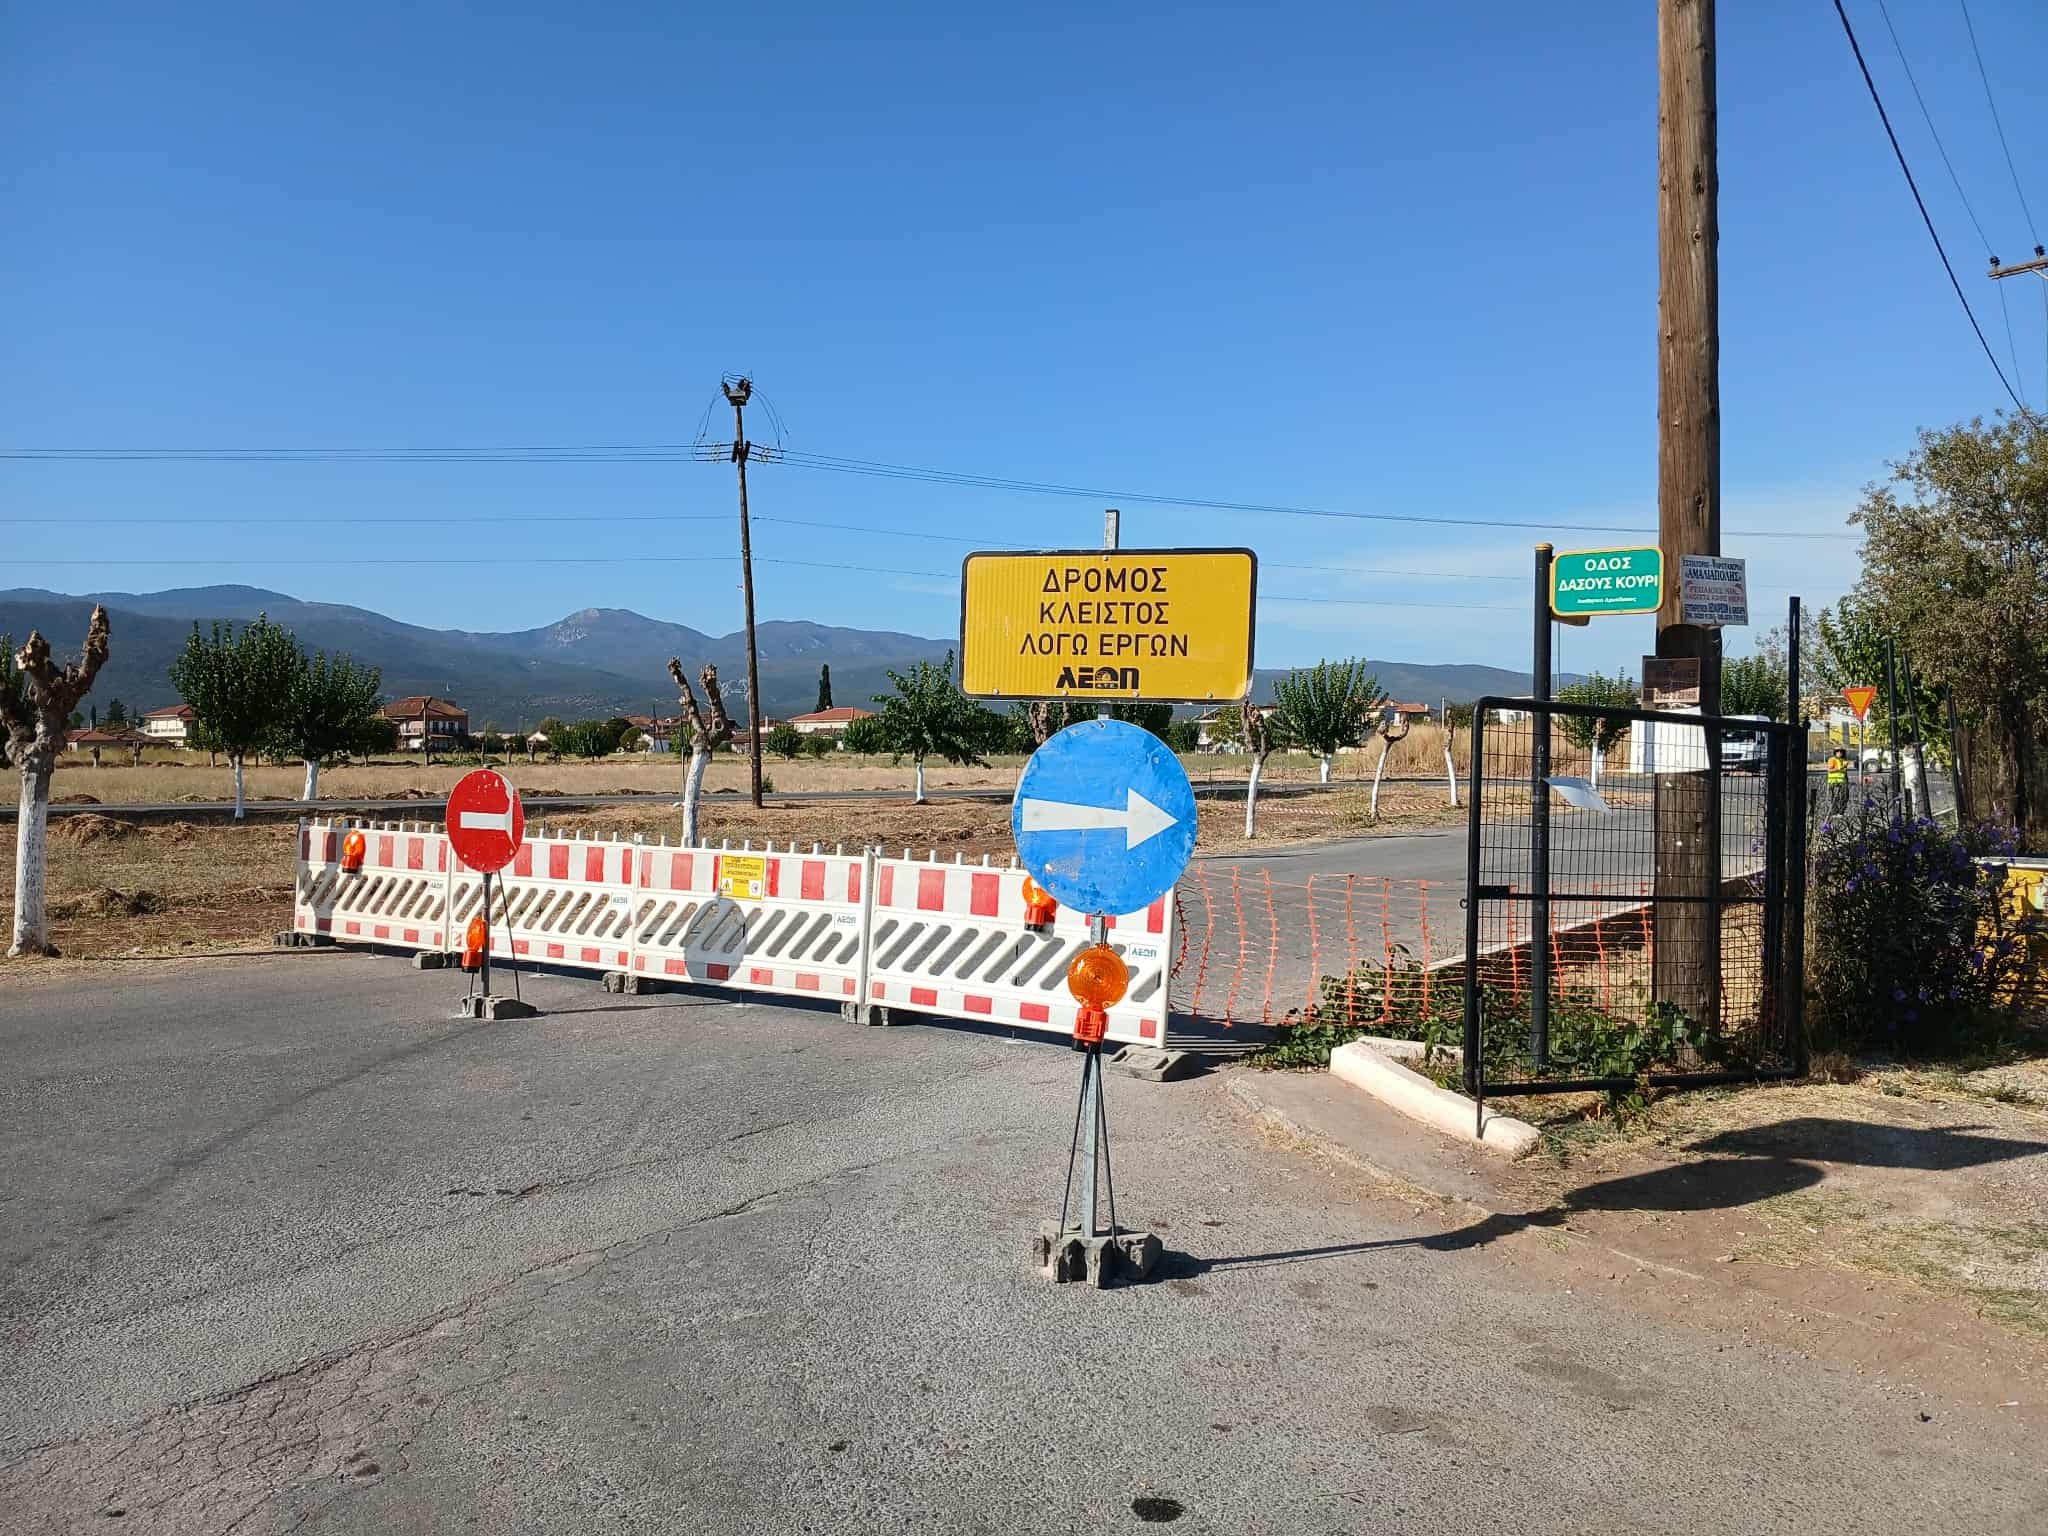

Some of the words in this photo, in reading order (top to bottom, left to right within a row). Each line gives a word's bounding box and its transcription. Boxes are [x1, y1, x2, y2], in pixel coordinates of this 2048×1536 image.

[1584, 557, 1632, 571] ΟΔΟΣ
[1042, 567, 1168, 593] ΔΡΟΜΟΣ
[1558, 576, 1613, 592] ΔΑΣΟΥΣ
[1615, 574, 1659, 589] ΚΟΥΡΙ
[1040, 601, 1169, 625] ΚΛΕΙΣΤΟΣ
[1020, 633, 1088, 655] ΛΟΓΩ
[1099, 634, 1188, 657] ΕΡΓΩΝ
